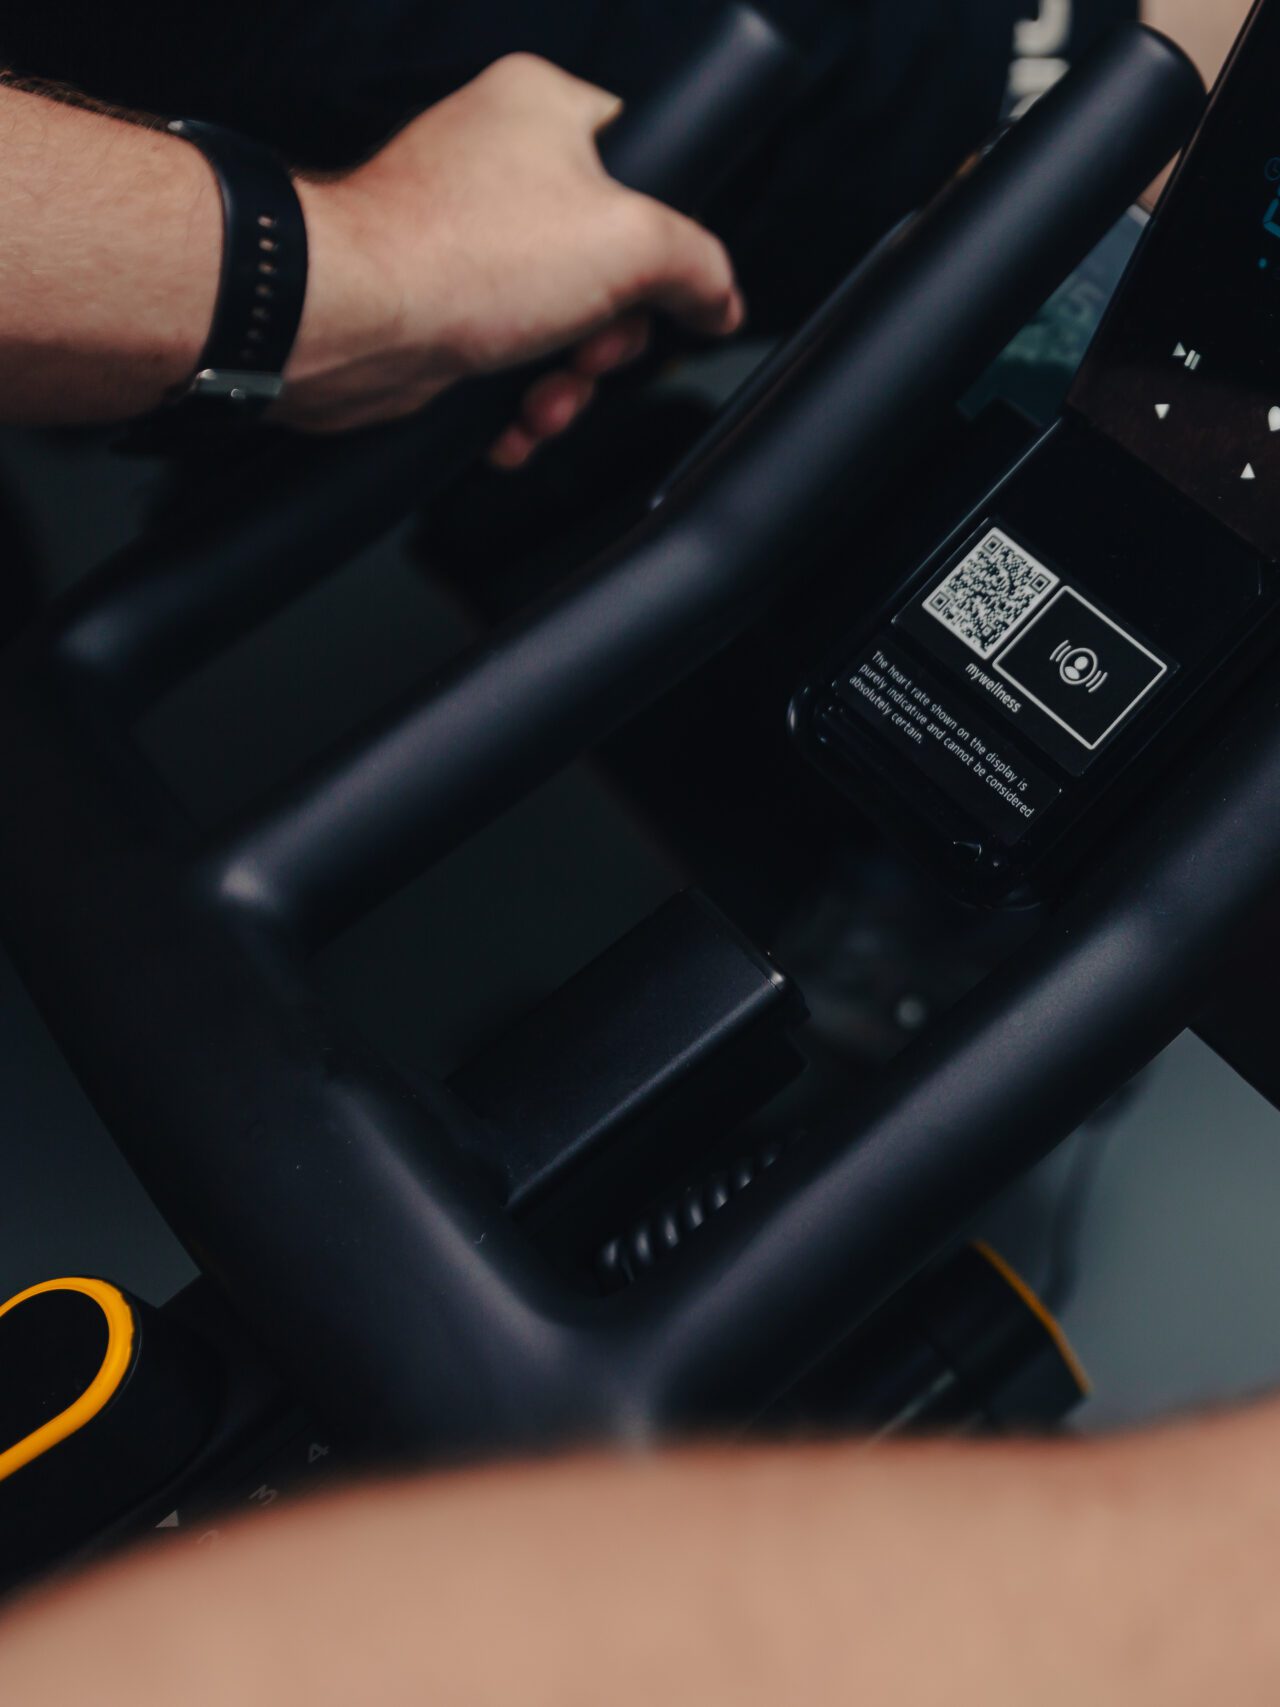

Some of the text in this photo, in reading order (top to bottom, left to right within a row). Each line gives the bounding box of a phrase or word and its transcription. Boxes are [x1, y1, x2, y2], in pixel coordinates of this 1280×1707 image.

[849, 675, 922, 744] absolutely certain.
[872, 650, 1028, 791] The heart rate shown on the display is
[965, 662, 1022, 713] mywellness
[858, 663, 1035, 818] purely indicative and cannot be considered
